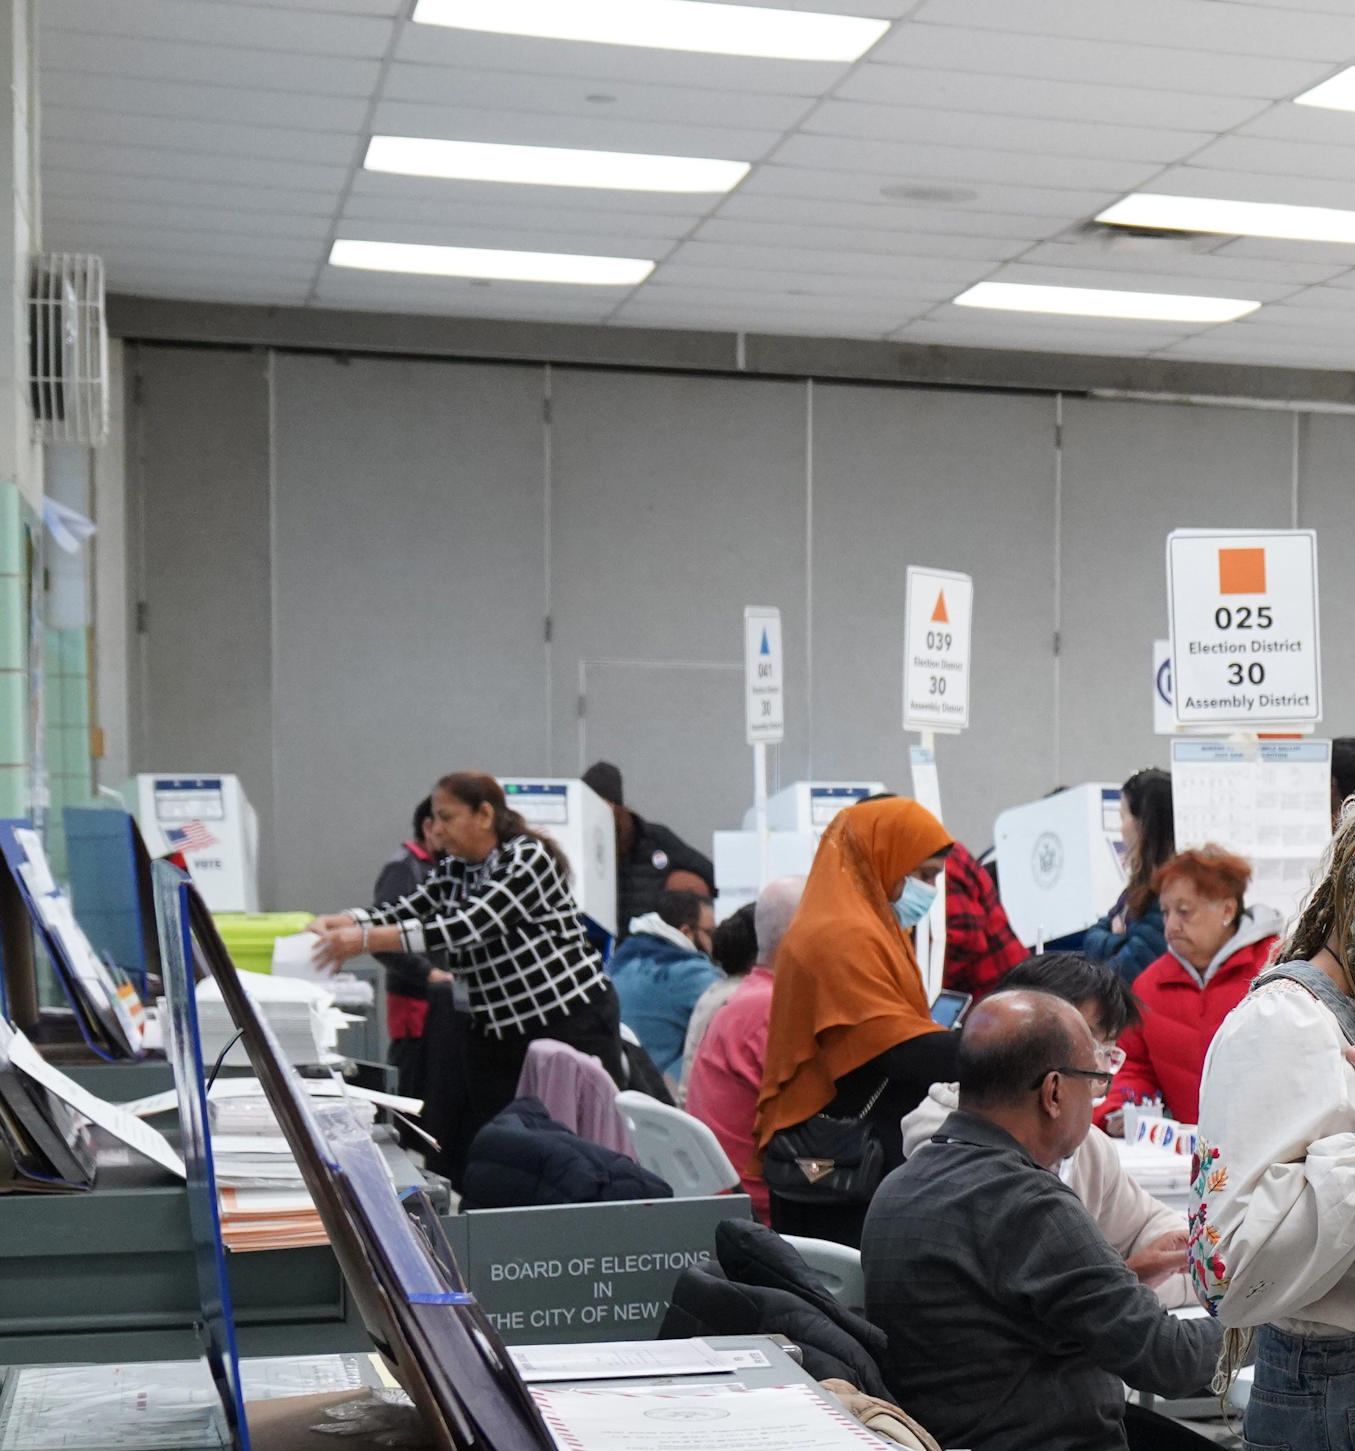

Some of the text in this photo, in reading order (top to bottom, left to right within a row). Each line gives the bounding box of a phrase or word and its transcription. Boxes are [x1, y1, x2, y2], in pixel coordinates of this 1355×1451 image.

[1214, 606, 1273, 630] 025
[926, 630, 952, 651] 039
[1188, 639, 1303, 655] Election District
[1227, 662, 1266, 686] 30
[928, 675, 947, 696] 30
[1184, 693, 1310, 711] Assembly District
[490, 1250, 712, 1281] BOARD OF ELECTIONS
[593, 1281, 613, 1298] IN
[486, 1311, 525, 1330] THE
[530, 1307, 576, 1327] CITY
[581, 1305, 609, 1324] OF
[614, 1301, 660, 1321] NEW
